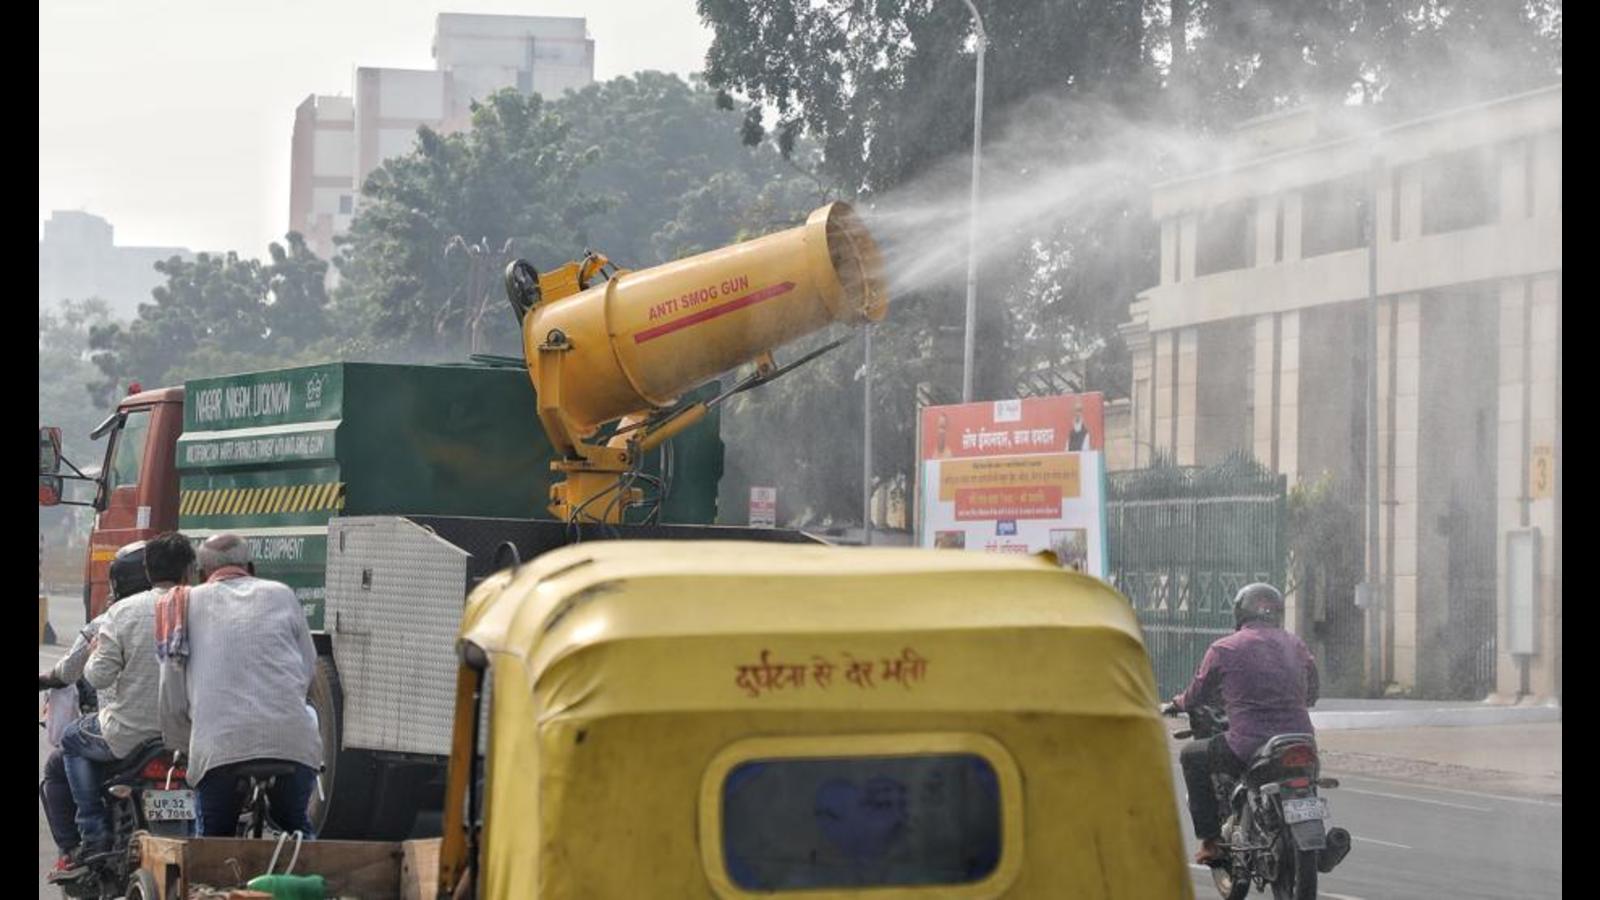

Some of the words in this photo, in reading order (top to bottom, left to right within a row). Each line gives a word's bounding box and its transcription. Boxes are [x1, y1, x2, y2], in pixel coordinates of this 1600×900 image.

[649, 301, 678, 321] ANTI
[681, 286, 718, 309] SMOG
[721, 274, 749, 295] GUN
[195, 388, 223, 423] NAGAR
[225, 386, 250, 419] NIGAM
[253, 382, 291, 417] LUCKNOW
[265, 538, 304, 560] EQUIPMENT
[734, 649, 806, 698] दुर्घटना
[810, 655, 836, 690] से
[841, 651, 876, 689] देर
[153, 799, 168, 809] UP
[172, 799, 184, 809] 32
